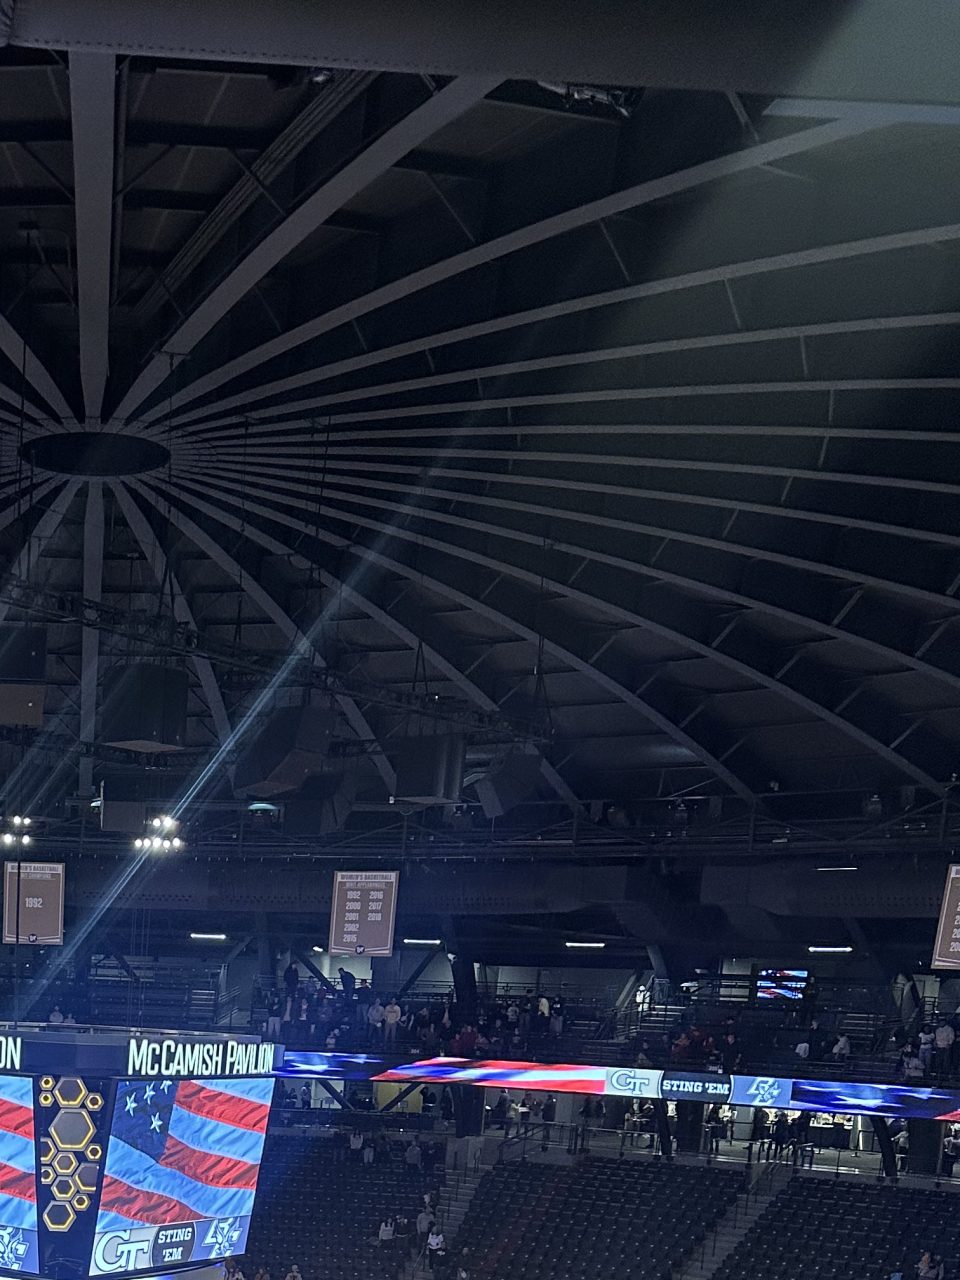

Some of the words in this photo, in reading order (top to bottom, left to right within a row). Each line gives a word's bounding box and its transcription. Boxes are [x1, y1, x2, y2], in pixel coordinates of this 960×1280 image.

[25, 897, 43, 908] 1992
[128, 1039, 222, 1076] McCAMISH
[226, 1042, 275, 1075] PAVILION
[662, 1079, 703, 1093] STING
[705, 1081, 730, 1095] 'EM
[158, 1225, 192, 1243] STING
[162, 1246, 182, 1261] 'EM
